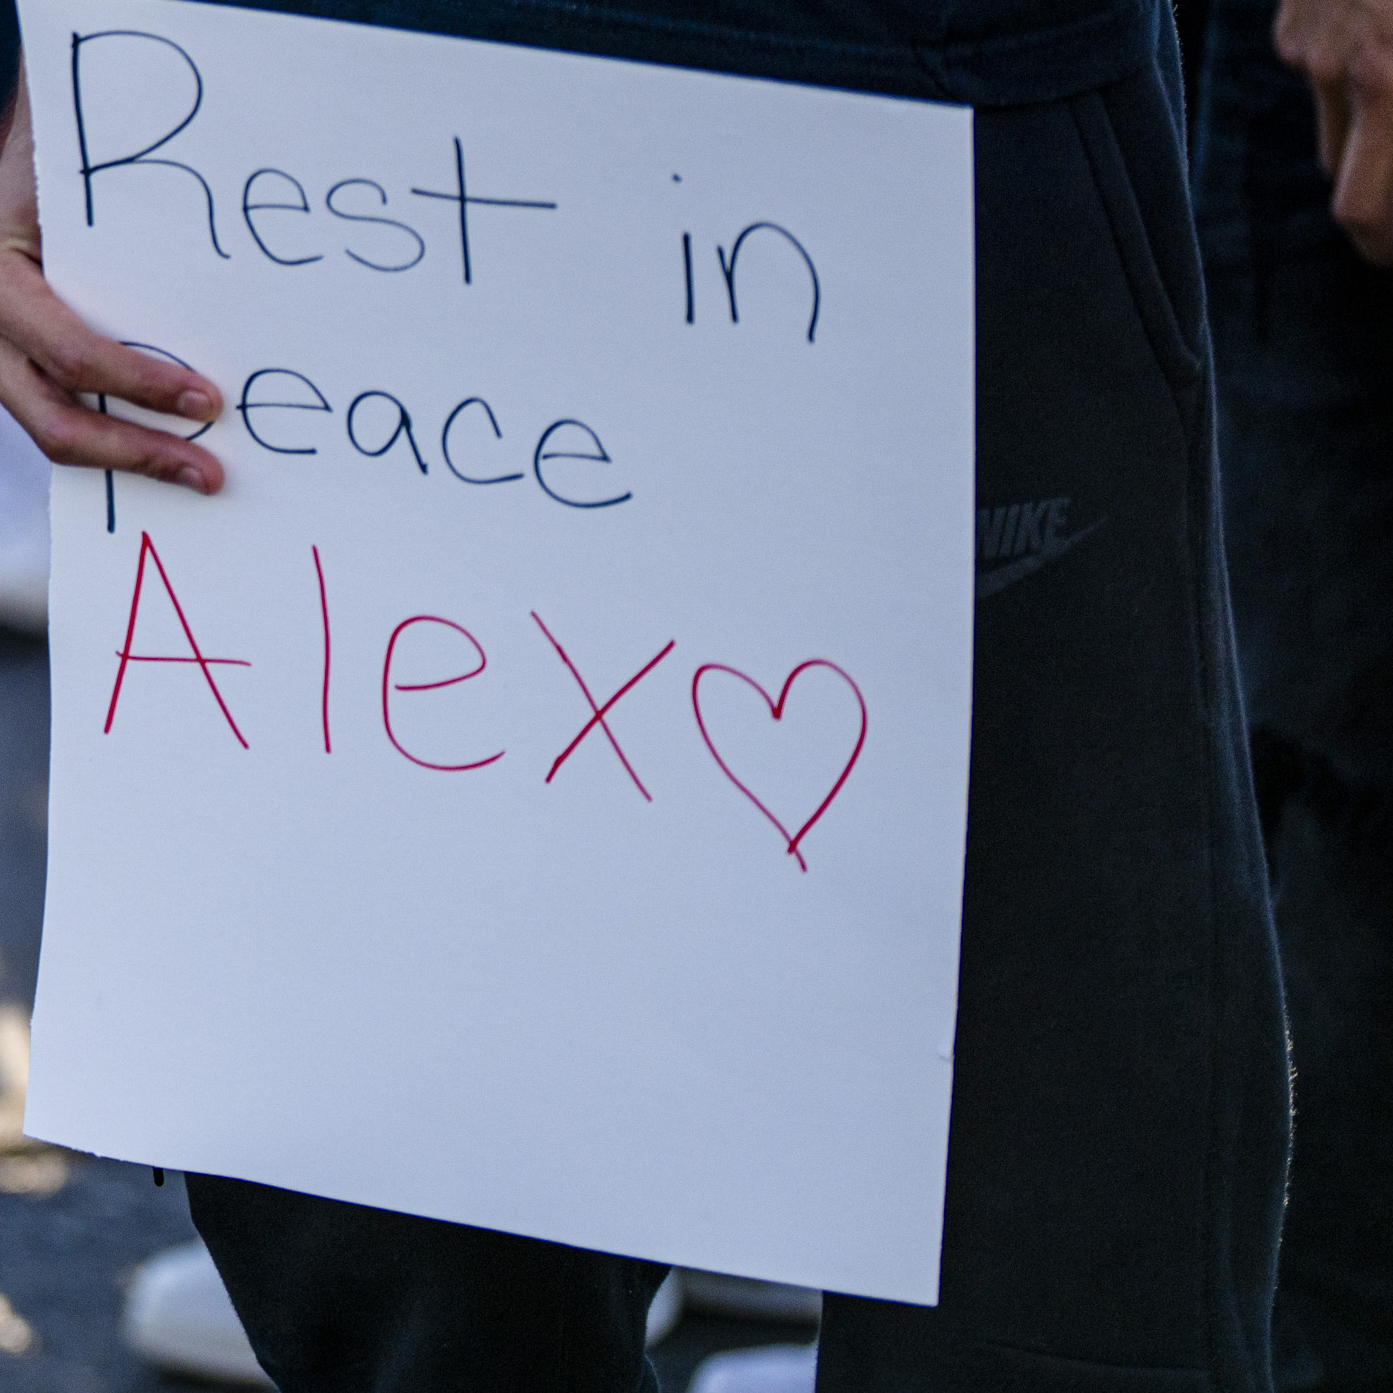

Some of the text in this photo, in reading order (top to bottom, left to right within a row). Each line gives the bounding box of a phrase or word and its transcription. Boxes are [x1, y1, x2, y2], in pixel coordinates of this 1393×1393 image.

[72, 29, 820, 344] Rest in
[103, 531, 675, 803] Alex
